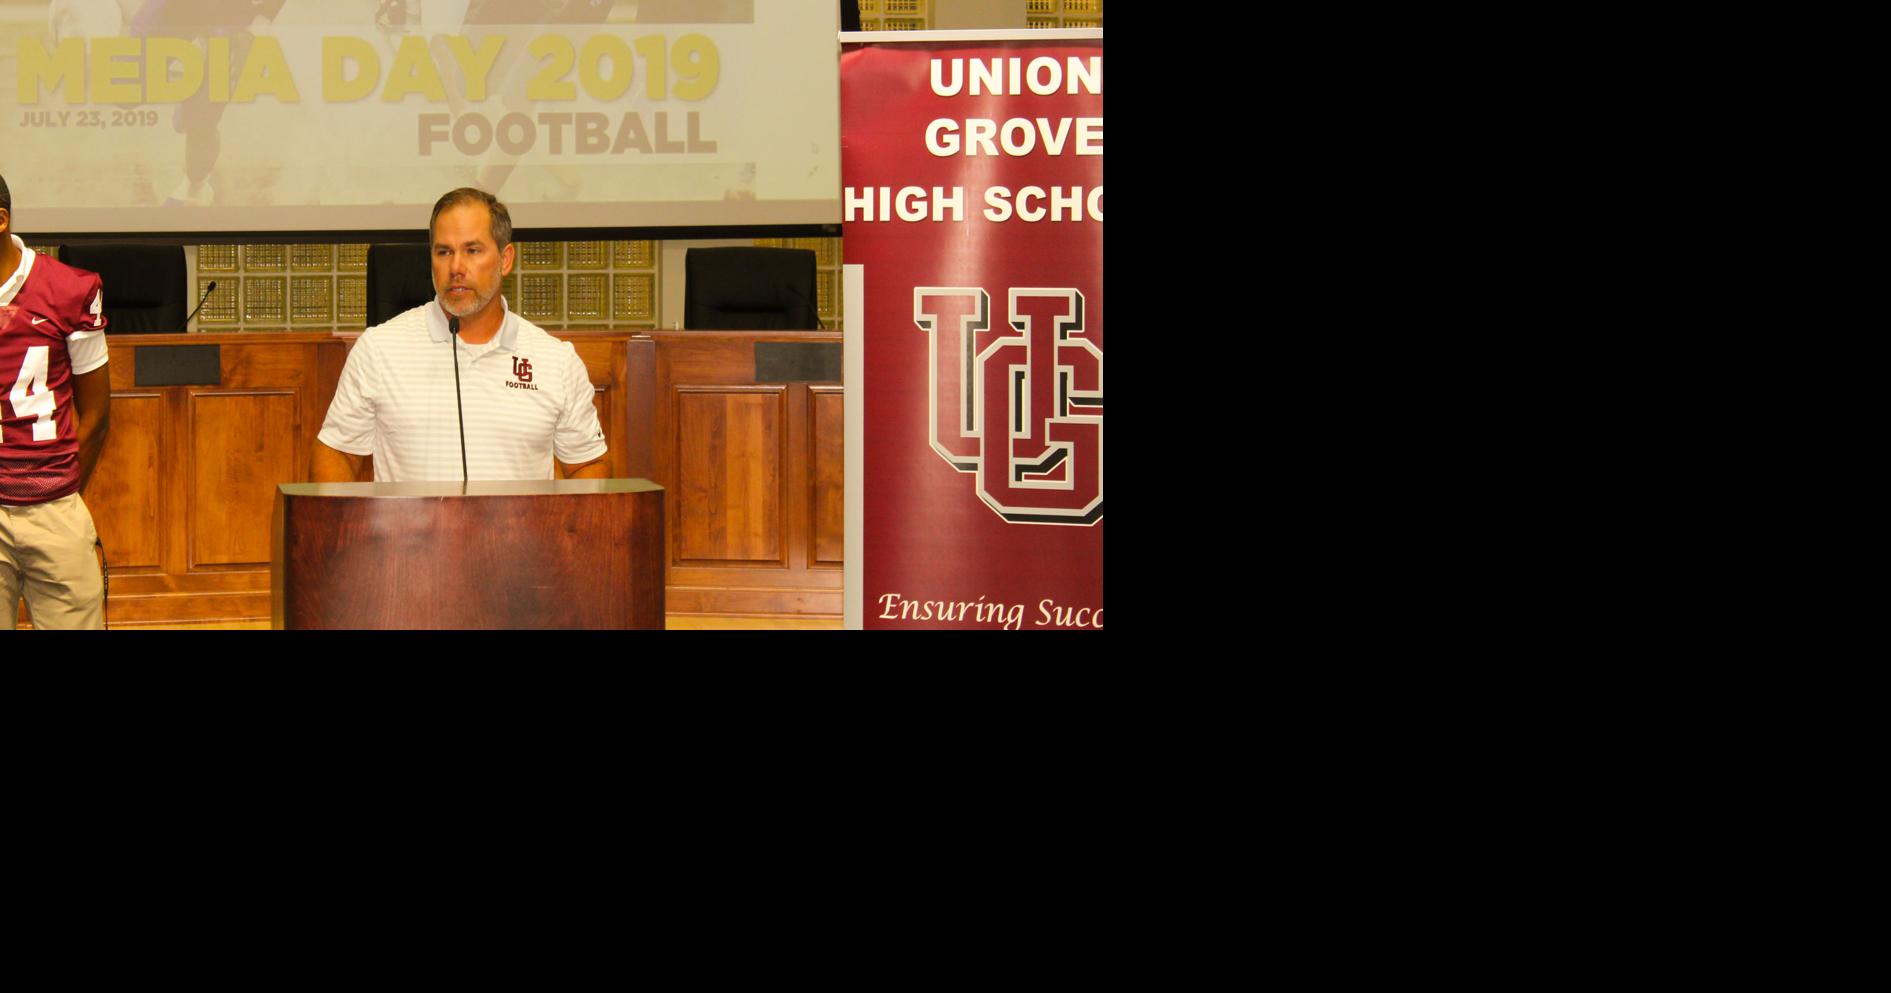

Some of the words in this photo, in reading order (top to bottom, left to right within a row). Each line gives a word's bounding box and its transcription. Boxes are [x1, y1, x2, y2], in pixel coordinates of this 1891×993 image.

[16, 36, 301, 105] MEDIA
[321, 34, 508, 103] DAY
[526, 33, 722, 103] 2019
[930, 56, 1101, 97] UNION
[19, 111, 71, 129] JULY
[76, 111, 106, 130] 23,
[111, 110, 159, 128] 2019
[417, 111, 717, 157] FOOTBALL
[925, 117, 1103, 156] GROVE
[844, 186, 964, 222] HIGH
[0, 345, 57, 442] 4
[505, 380, 538, 391] FOOTBALL
[878, 593, 1025, 630] Ensuring
